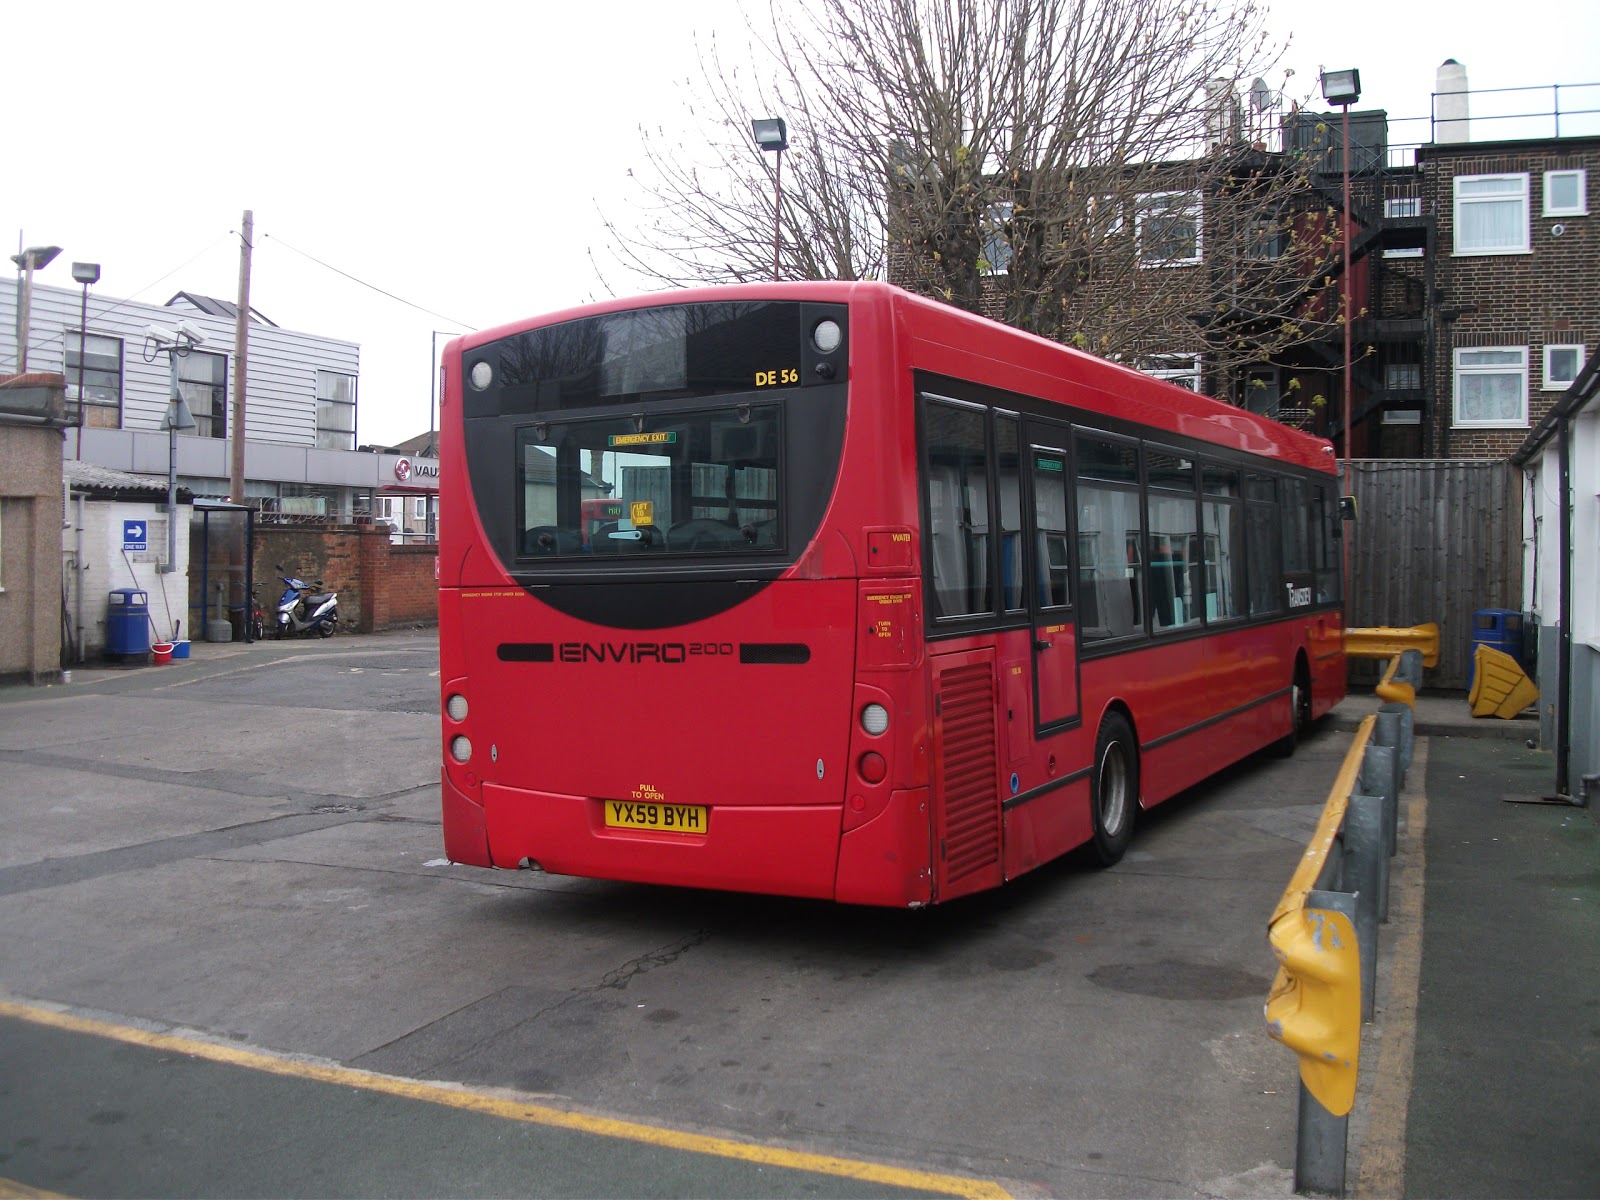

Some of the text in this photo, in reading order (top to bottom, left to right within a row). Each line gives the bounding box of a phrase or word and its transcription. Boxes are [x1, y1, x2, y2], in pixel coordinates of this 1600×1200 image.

[755, 368, 799, 386] DE 56
[616, 433, 665, 444] EMERGENCY EXIT
[636, 503, 648, 511] LIFT
[559, 643, 733, 664] ENVIRO 200
[640, 784, 656, 792] PULL
[631, 791, 664, 800] TO OPEN
[613, 803, 699, 827] YX59 BYH
